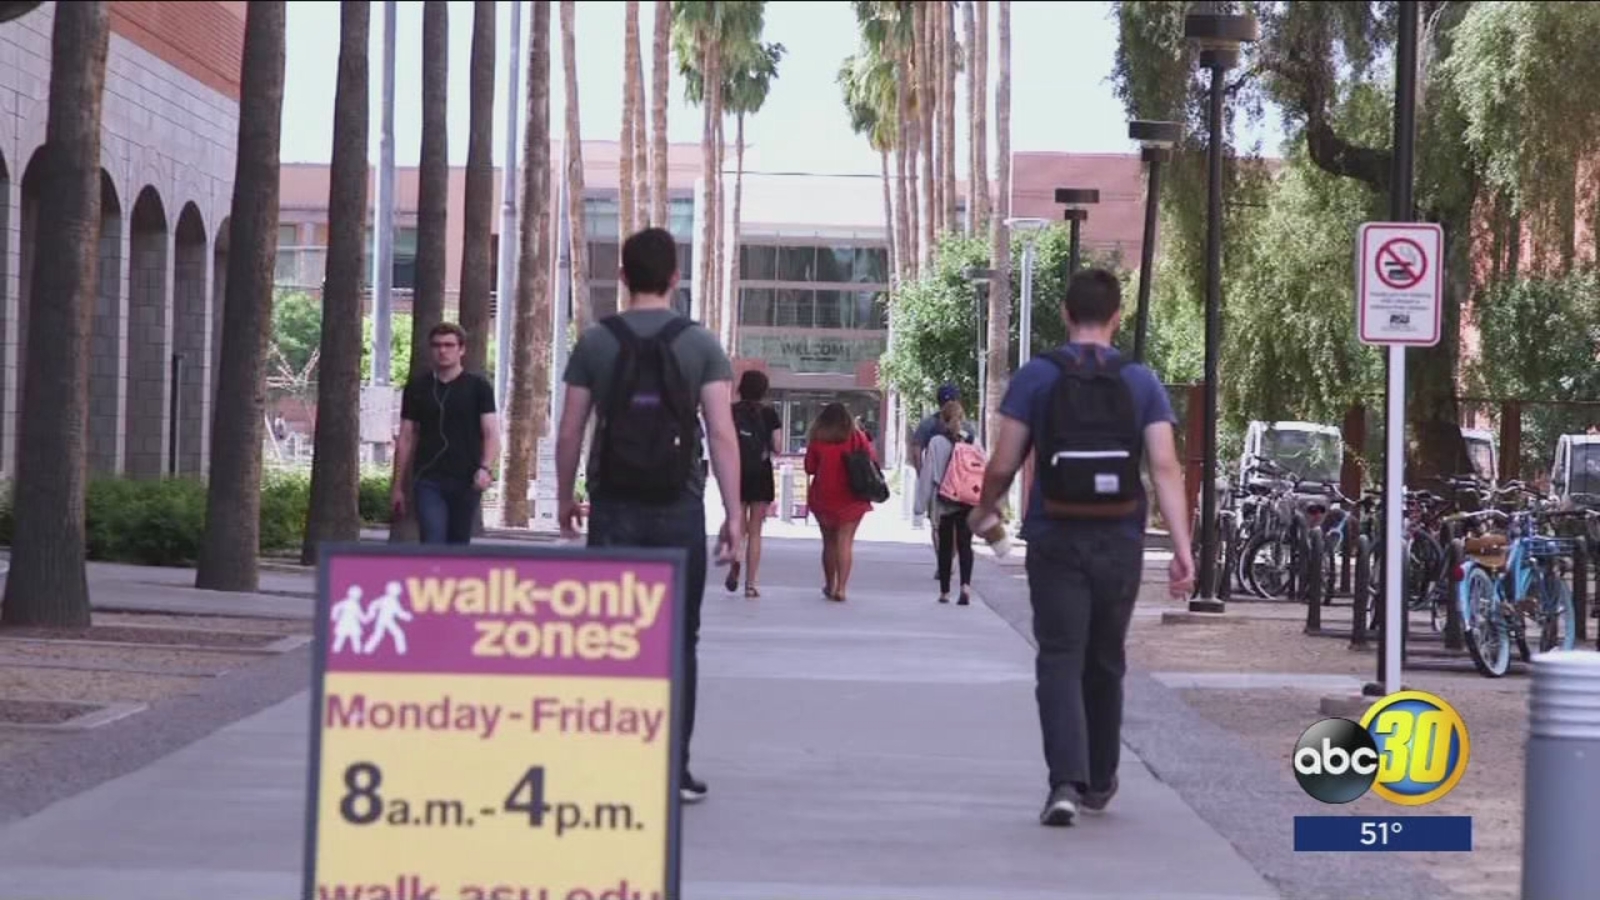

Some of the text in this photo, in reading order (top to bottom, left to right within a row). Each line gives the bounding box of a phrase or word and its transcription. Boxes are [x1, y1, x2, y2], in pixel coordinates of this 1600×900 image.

[406, 568, 666, 628] walk-only
[472, 620, 640, 660] zones
[325, 694, 502, 739] Monday
[531, 698, 664, 743] Friday
